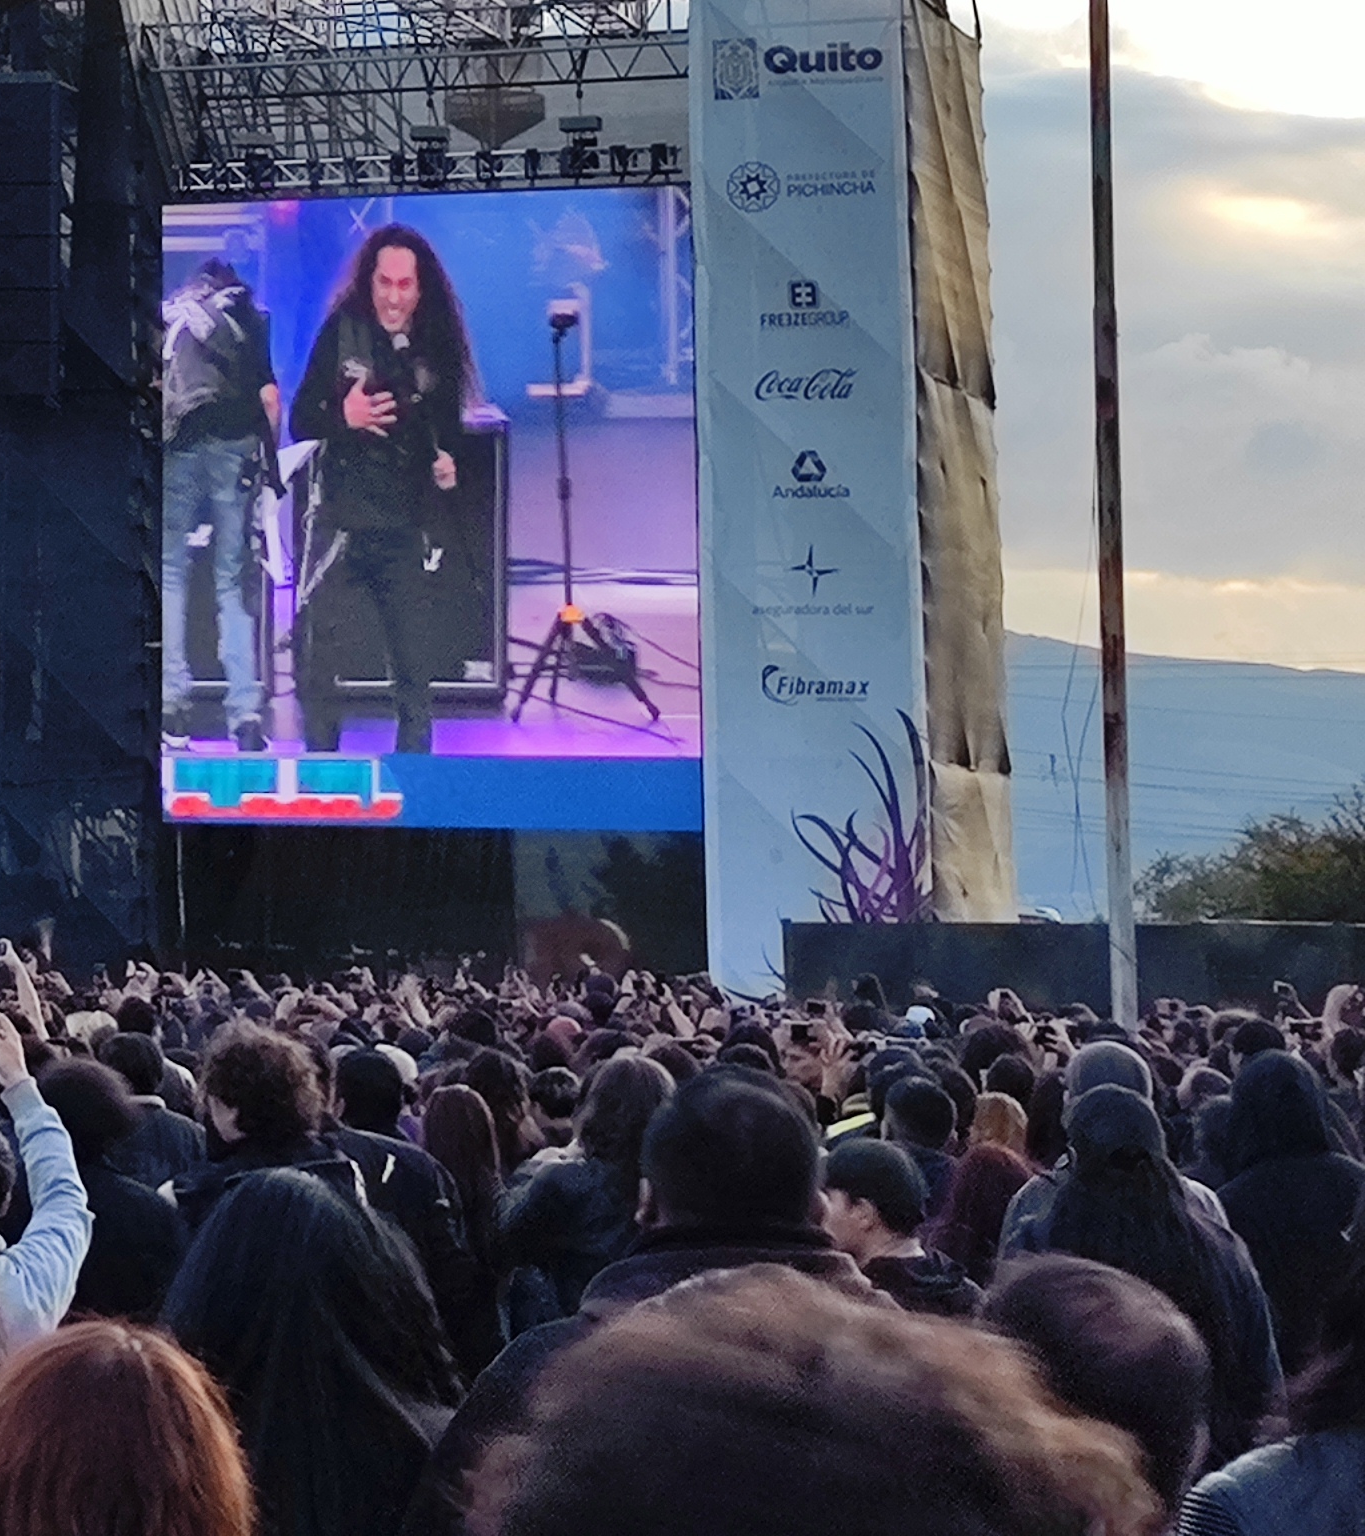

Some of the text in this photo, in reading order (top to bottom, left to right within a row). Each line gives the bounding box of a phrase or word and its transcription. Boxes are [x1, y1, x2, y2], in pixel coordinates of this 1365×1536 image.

[764, 42, 881, 74] Quito
[861, 169, 875, 179] DE
[787, 180, 876, 197] PICHINCHA
[772, 484, 850, 498] Andalucía
[832, 603, 852, 615] del
[776, 676, 869, 695] Fibramax
